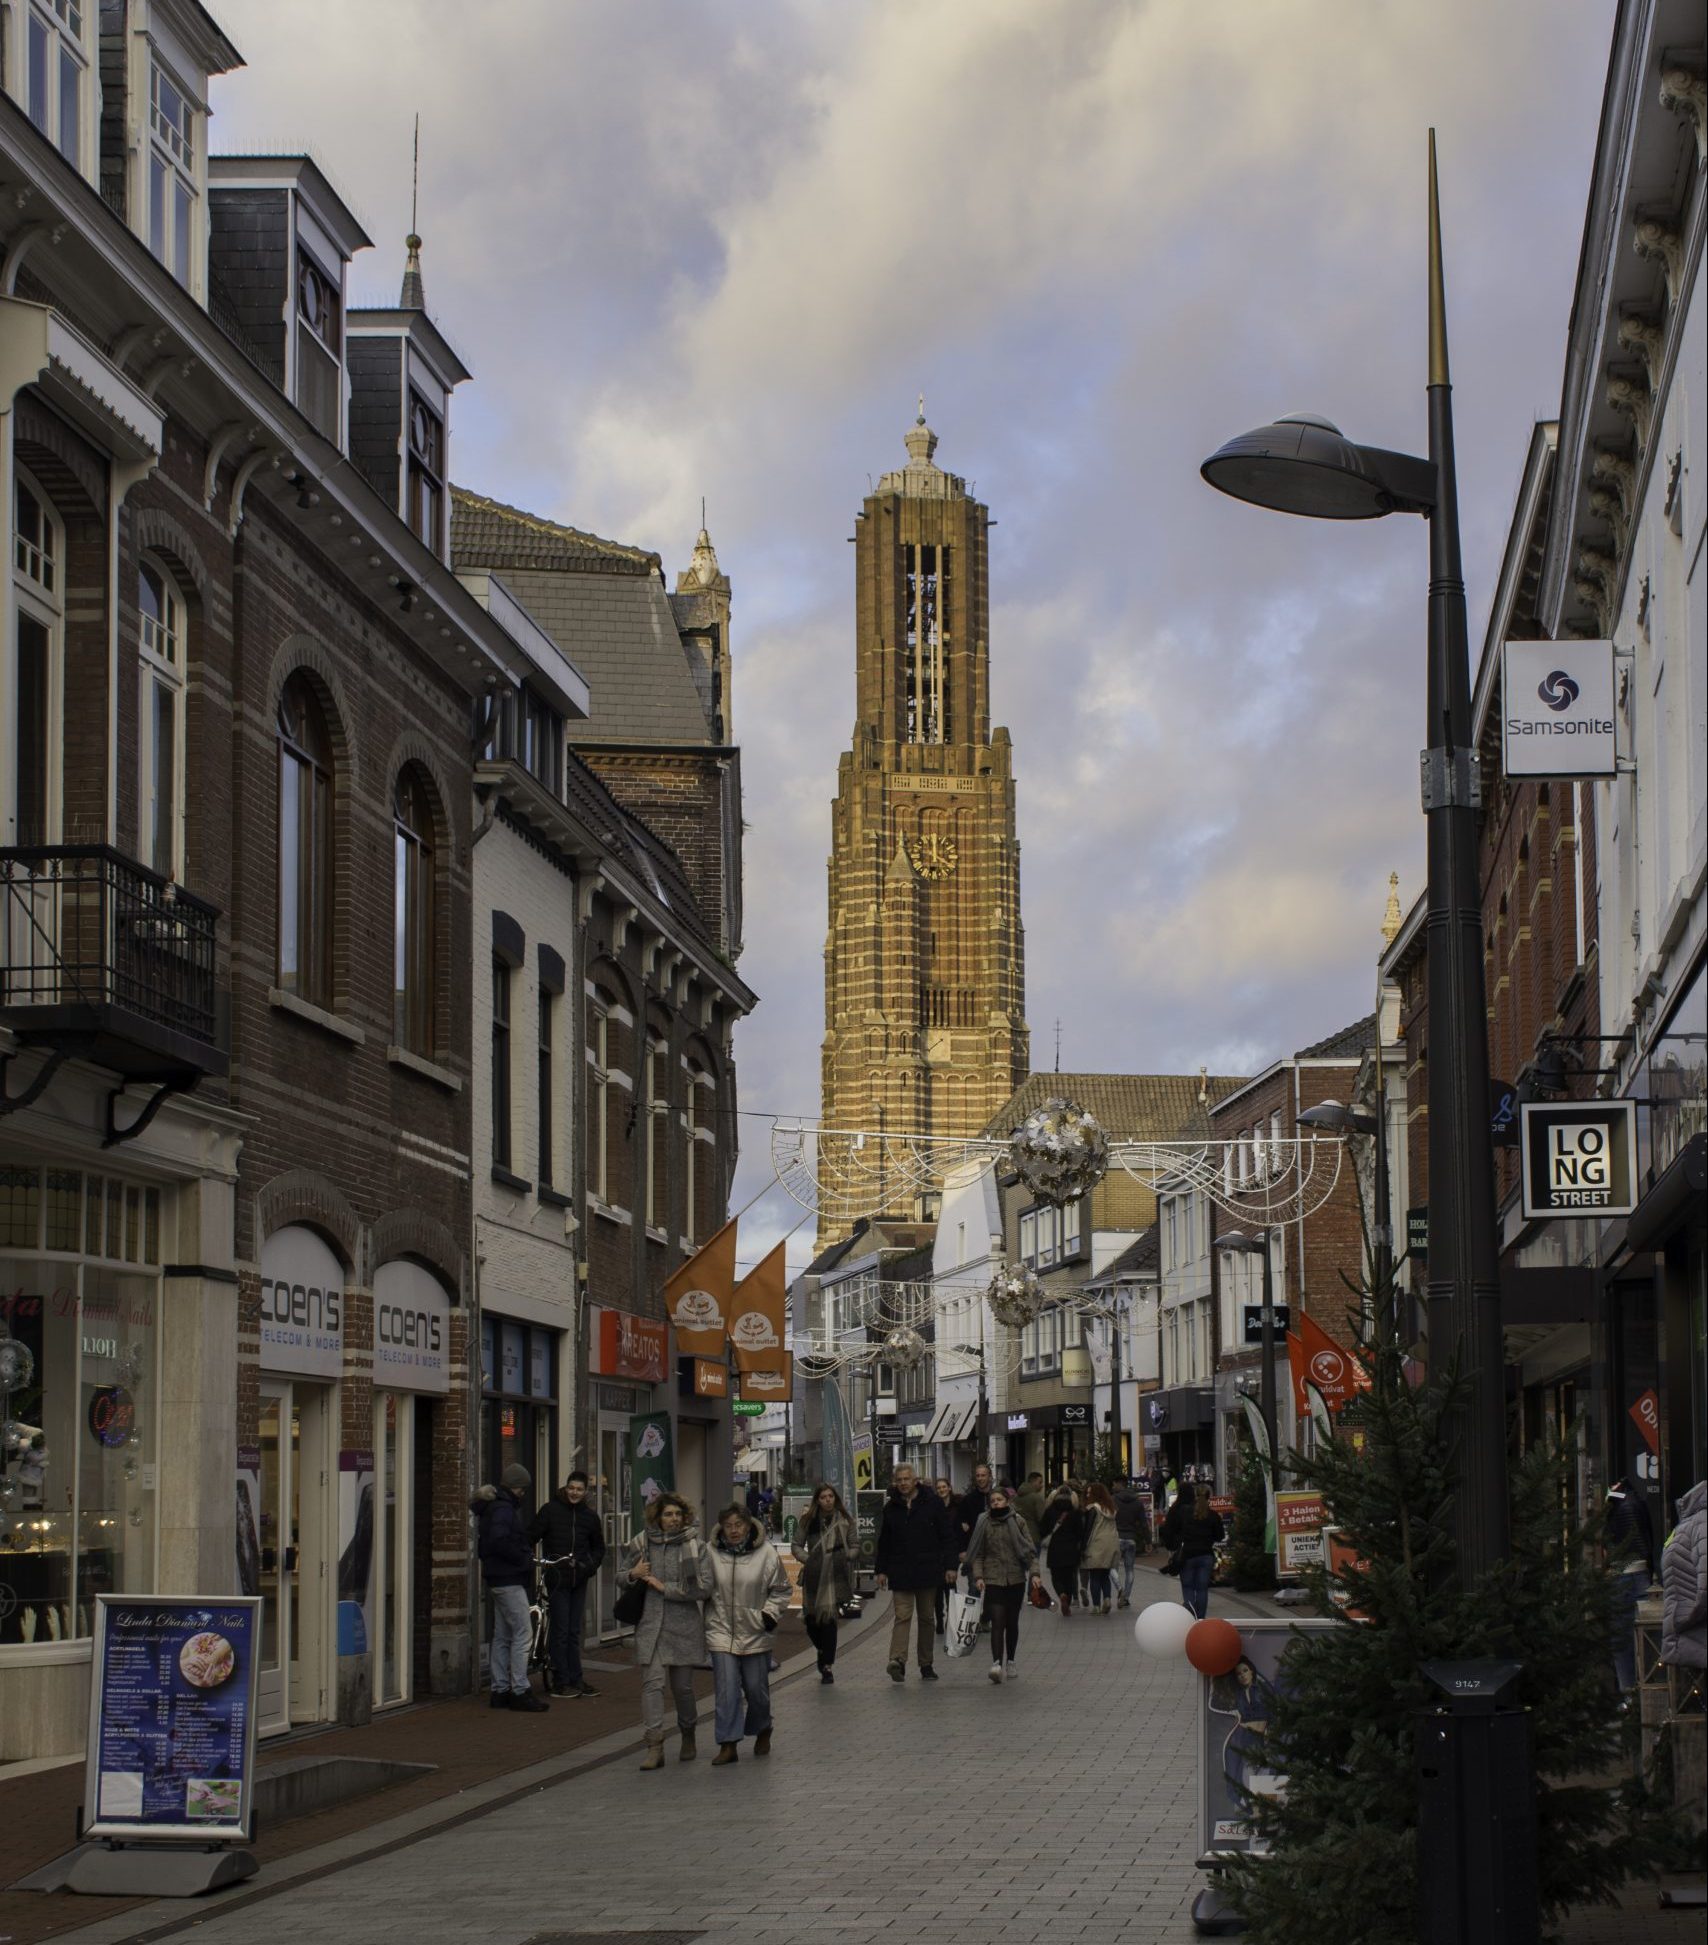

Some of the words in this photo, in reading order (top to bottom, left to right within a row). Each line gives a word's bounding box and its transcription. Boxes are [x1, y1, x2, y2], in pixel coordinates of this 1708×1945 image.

[1507, 718, 1614, 736] Samsonite
[1556, 1127, 1604, 1156] LO
[1555, 1157, 1605, 1186] NG
[1550, 1190, 1612, 1206] STREET
[315, 1338, 340, 1351] MORE
[755, 1336, 777, 1345] outlet
[379, 1349, 413, 1365] TELECOM
[422, 1356, 441, 1370] MORE
[1283, 1508, 1291, 1517] 3
[1280, 1518, 1286, 1526] 1
[1291, 1535, 1319, 1544] UNIEK
[114, 1611, 154, 1628] Linda
[216, 1613, 246, 1629] Nails
[1455, 1679, 1481, 1689] 9147
